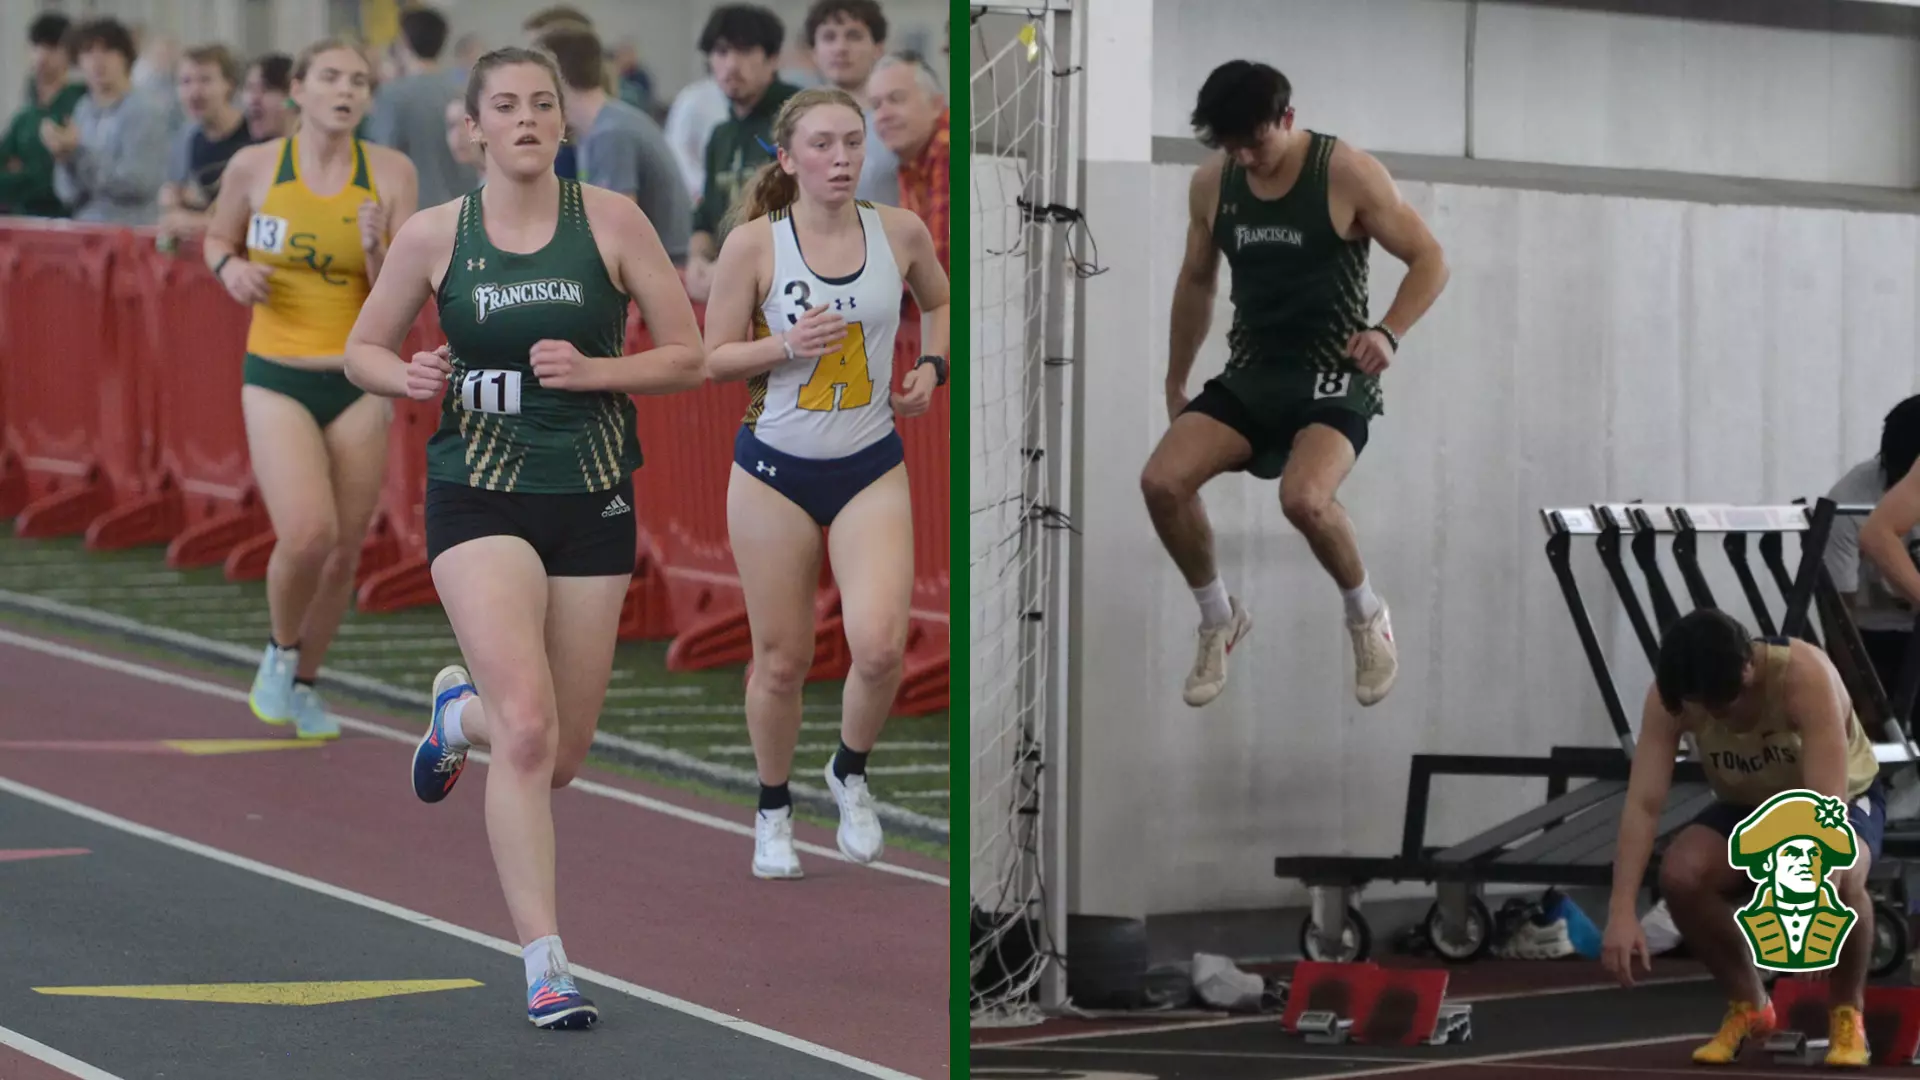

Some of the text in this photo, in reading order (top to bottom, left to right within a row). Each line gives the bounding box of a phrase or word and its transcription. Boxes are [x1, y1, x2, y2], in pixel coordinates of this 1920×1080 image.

[254, 218, 279, 248] 13
[1235, 224, 1302, 251] FRANCISCAN
[473, 279, 584, 323] FRANCISCAN
[784, 280, 814, 325] 3
[796, 321, 874, 411] A
[1318, 371, 1344, 396] 8
[468, 371, 506, 412] 11
[601, 504, 631, 518] adidas
